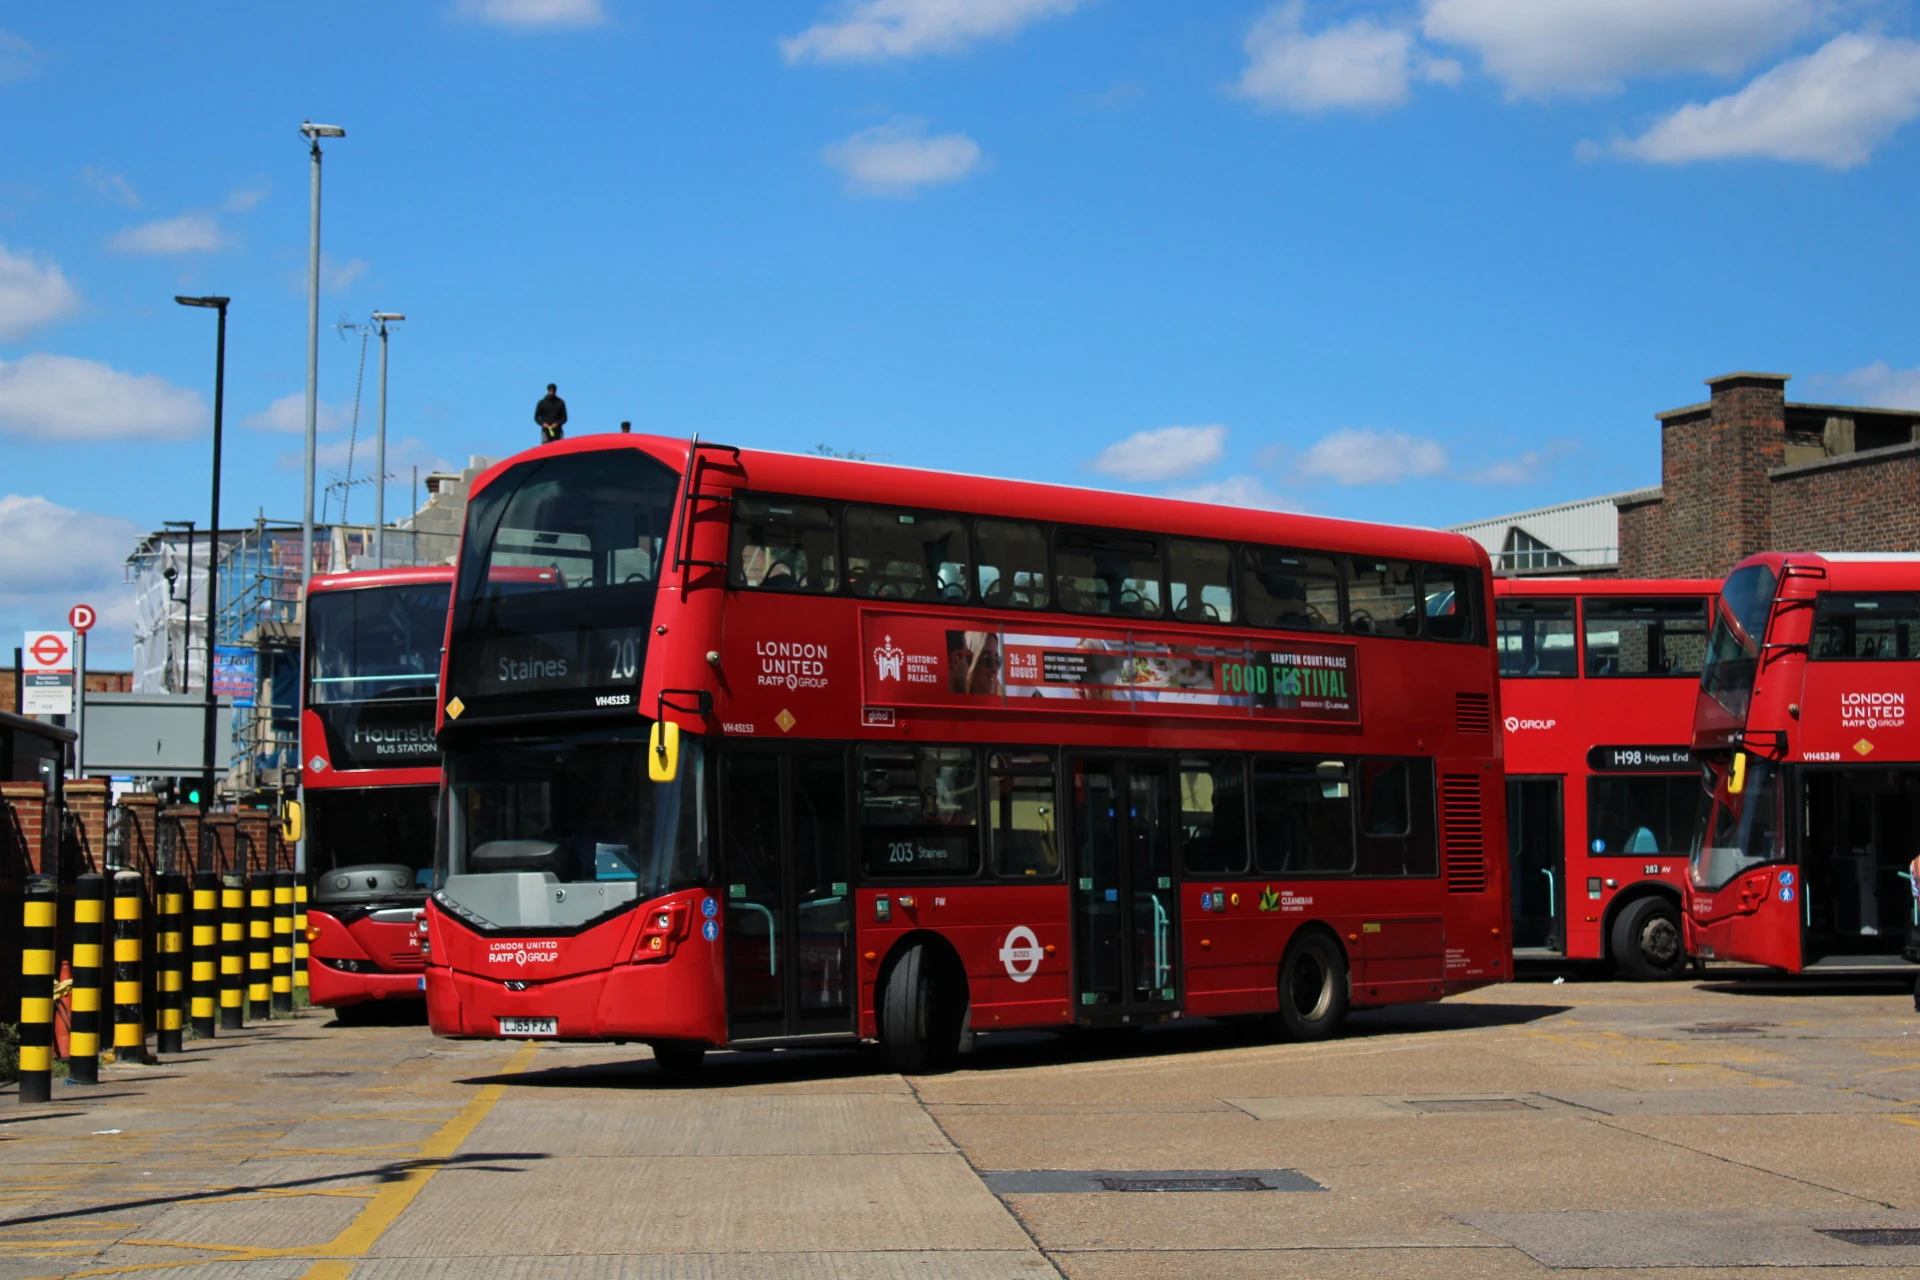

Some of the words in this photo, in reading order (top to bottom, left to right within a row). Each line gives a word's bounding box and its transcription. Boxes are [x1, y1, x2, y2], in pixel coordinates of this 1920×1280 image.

[74, 608, 92, 628] D
[756, 641, 828, 659] LONDON
[611, 638, 640, 678] 20
[906, 655, 938, 664] HISTORIC
[1010, 654, 1020, 665] 26
[1027, 655, 1037, 666] 28
[1271, 653, 1301, 665] HAMPTON
[1302, 655, 1323, 666] COURT
[1324, 657, 1347, 668] PALACE
[498, 657, 567, 681] Staines
[762, 659, 824, 675] UNITED
[907, 664, 929, 673] ROYAL
[1010, 667, 1038, 679] AUGUST
[757, 675, 784, 686] RATP
[797, 677, 828, 688] GROUP
[907, 674, 937, 683] PALACES
[1222, 664, 1267, 694] FOOD
[1273, 667, 1347, 698] FESTIVAL
[596, 694, 630, 706] VH45153
[1841, 693, 1904, 704] LONDON
[868, 711, 889, 723] global
[1841, 706, 1905, 718] UNITED
[722, 723, 754, 733] VH45153
[1520, 719, 1556, 729] GROUP
[1842, 719, 1866, 727] RATP
[1877, 719, 1904, 727] GROUP
[355, 723, 437, 743] Hounslo
[376, 744, 395, 754] BUS
[397, 743, 437, 753] STATION
[1614, 751, 1641, 765] H98
[1645, 753, 1671, 763] Hayes
[1672, 753, 1689, 762] End
[1803, 752, 1840, 761] VH45249
[888, 842, 914, 862] 203
[918, 847, 948, 858] Staines
[1645, 864, 1659, 873] 282
[935, 897, 946, 906] FW
[490, 942, 523, 951] LONDON
[526, 941, 557, 949] UNITED
[488, 953, 514, 962] RATP
[527, 952, 558, 962] GROUP
[504, 1018, 530, 1032] LJ65
[532, 1018, 552, 1032] FZK
